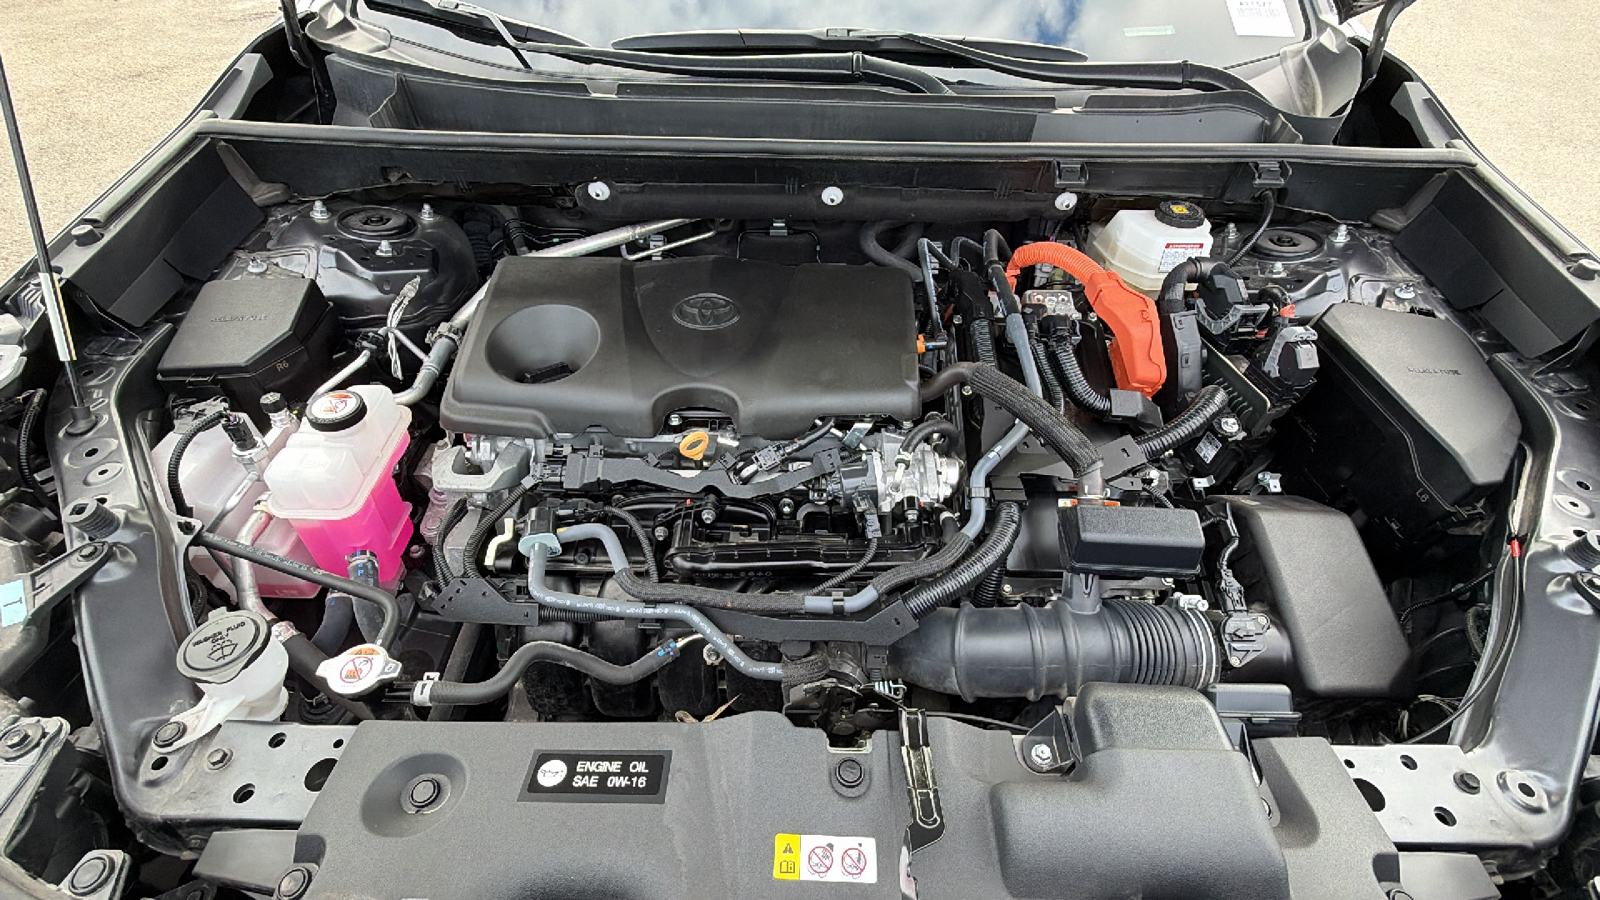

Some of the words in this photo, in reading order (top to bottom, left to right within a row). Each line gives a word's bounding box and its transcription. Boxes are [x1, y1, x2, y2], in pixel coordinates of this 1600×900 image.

[275, 360, 289, 372] R6
[1416, 488, 1429, 502] L6
[226, 621, 246, 633] FLUID
[576, 761, 623, 773] ENGINE
[629, 761, 649, 773] OIL
[572, 775, 599, 788] SAE
[606, 776, 647, 788] 0W-16
